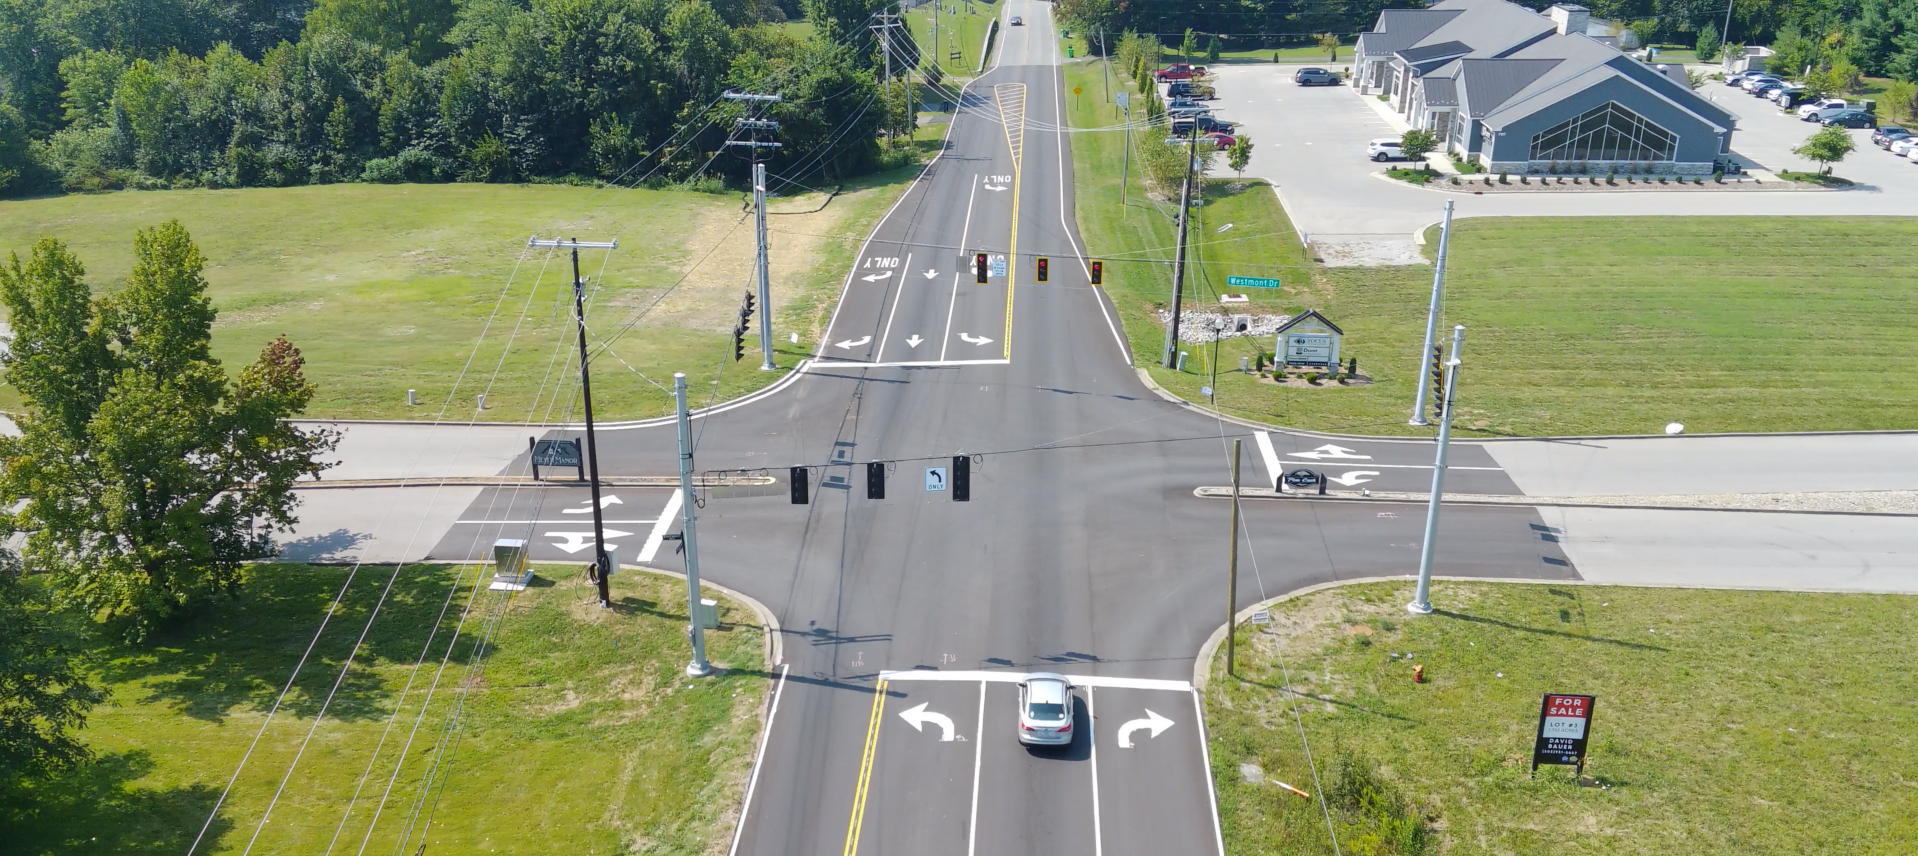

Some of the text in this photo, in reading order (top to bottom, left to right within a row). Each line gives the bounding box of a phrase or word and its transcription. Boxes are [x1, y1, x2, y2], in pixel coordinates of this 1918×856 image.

[983, 175, 1012, 183] ONLY
[863, 257, 900, 268] ONLY
[1230, 278, 1267, 286] Westmont
[1556, 698, 1582, 706] FOR
[1550, 707, 1583, 716] SALE
